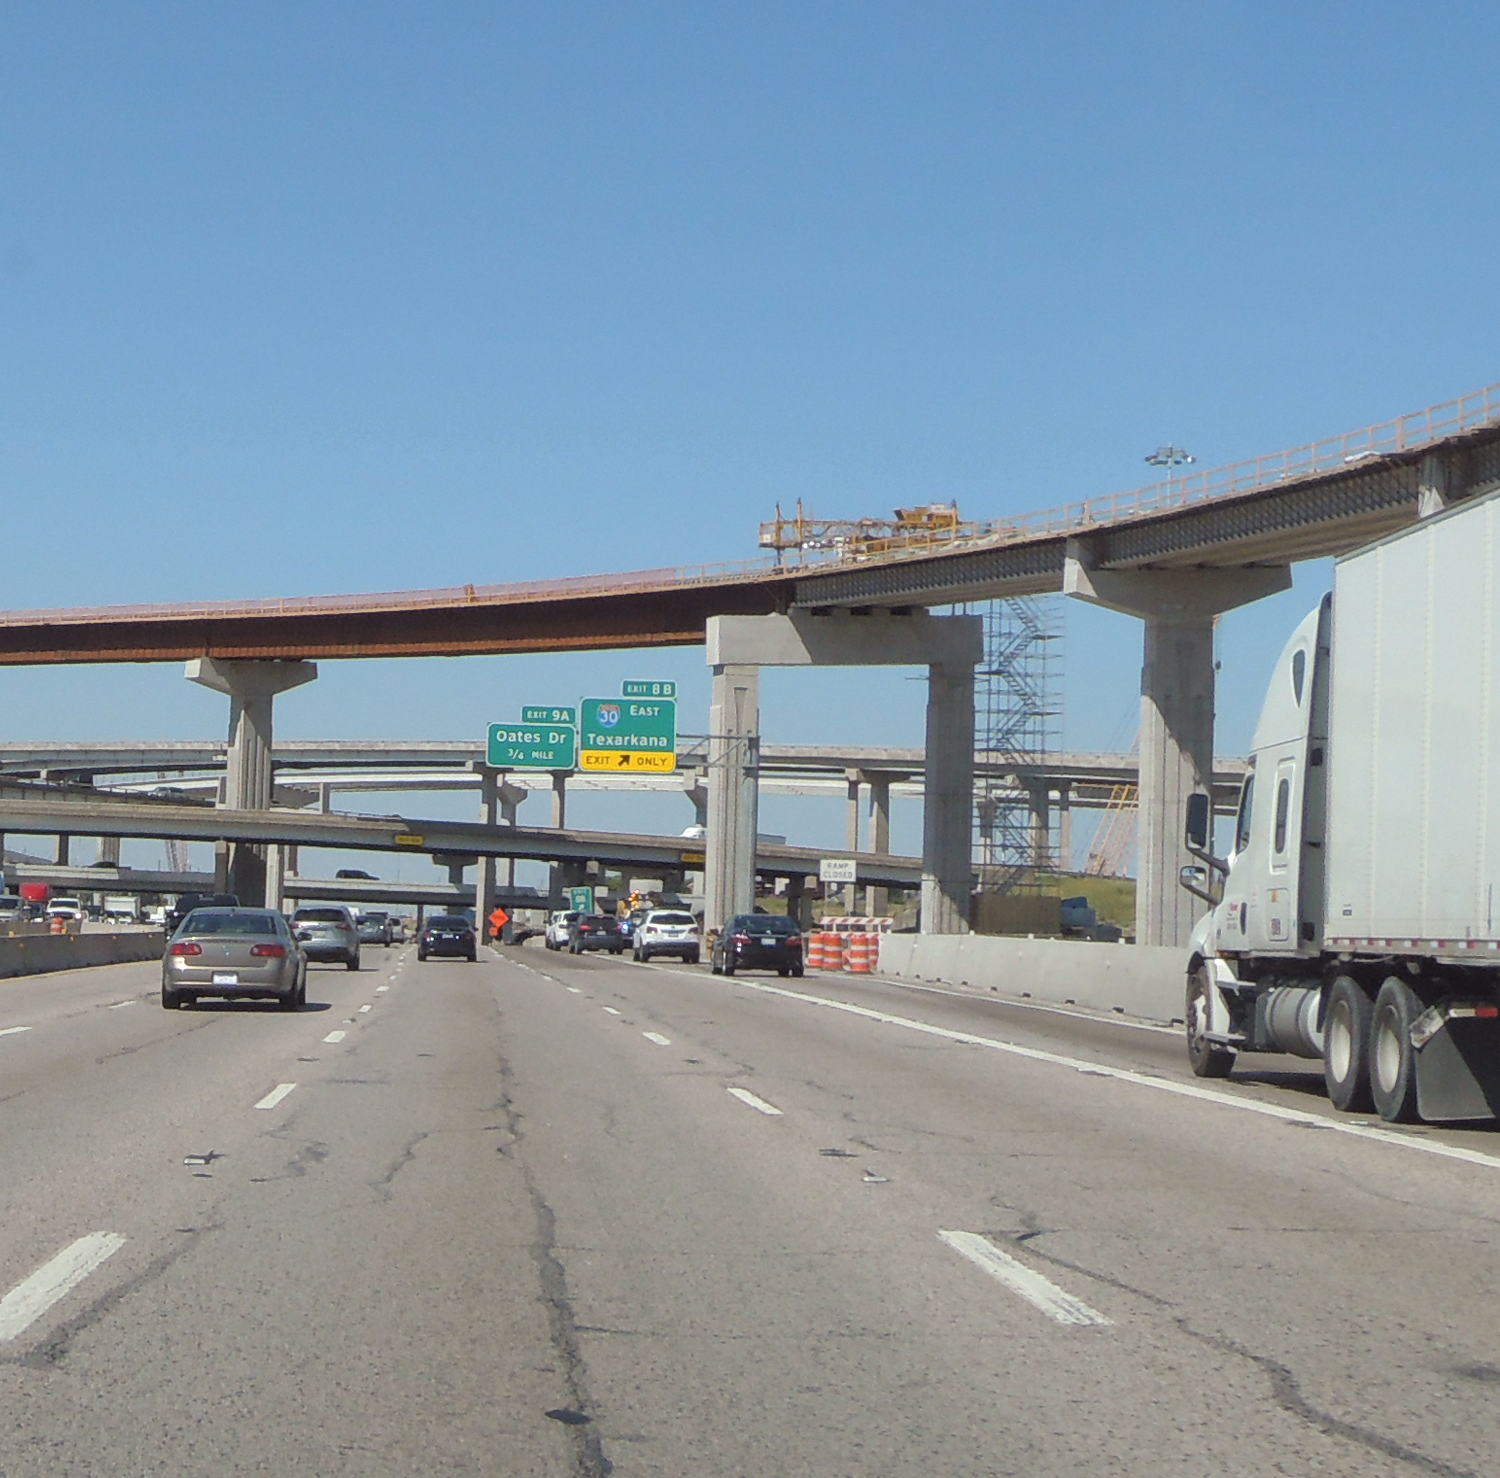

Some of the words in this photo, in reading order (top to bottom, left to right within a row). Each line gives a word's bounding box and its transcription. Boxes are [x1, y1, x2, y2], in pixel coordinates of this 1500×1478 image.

[627, 684, 648, 693] EXIT
[526, 710, 548, 719] EXIT
[552, 710, 570, 721] 9A
[630, 705, 660, 716] EAST
[600, 714, 618, 723] 30
[496, 730, 541, 743] Oates
[548, 732, 567, 744] Dr
[587, 733, 668, 747] Texarkana
[508, 749, 524, 760] 3/4
[531, 751, 554, 760] MILE
[586, 756, 611, 765] EXIT
[636, 757, 668, 767] ONLY
